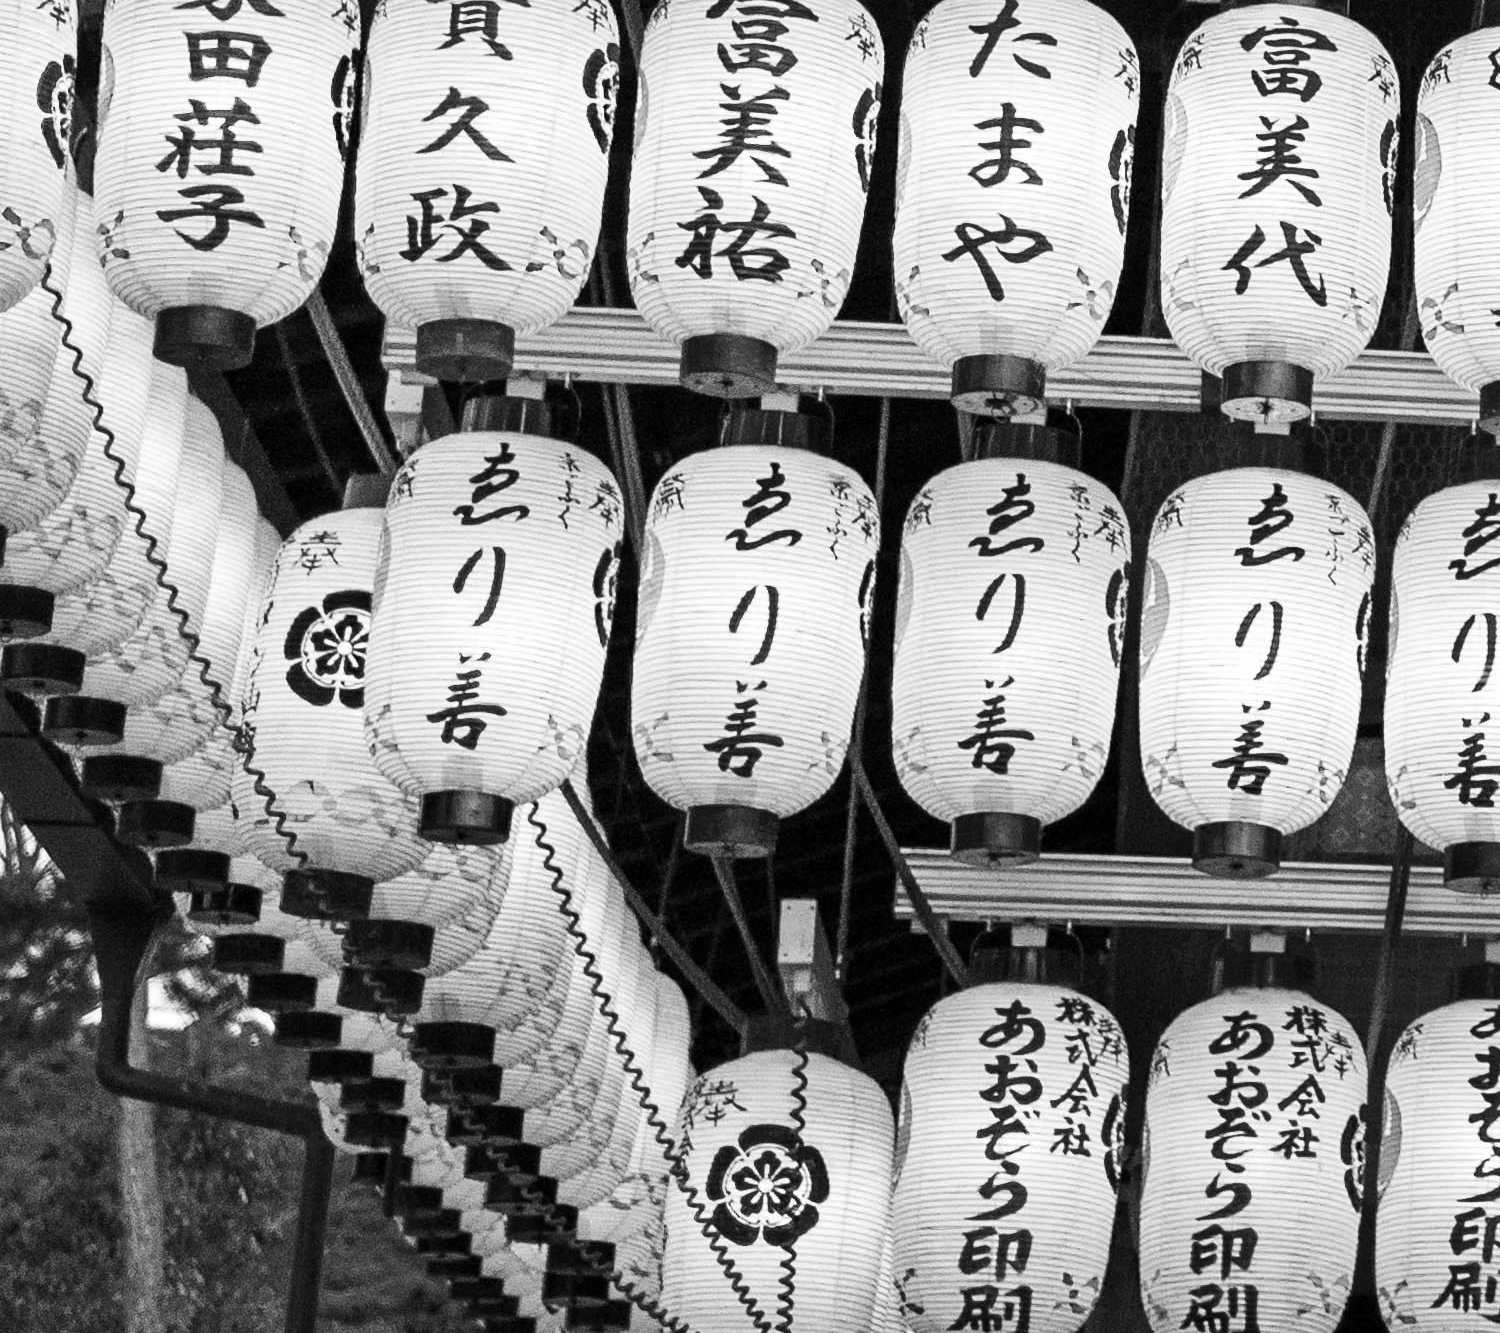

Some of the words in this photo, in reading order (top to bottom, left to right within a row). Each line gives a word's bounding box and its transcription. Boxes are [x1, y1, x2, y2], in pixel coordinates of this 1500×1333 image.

[942, 0, 1057, 301] たまや
[1221, 17, 1337, 306] 富美代
[1050, 996, 1098, 1158] 株式会社
[1270, 1004, 1327, 1160] 株式会社
